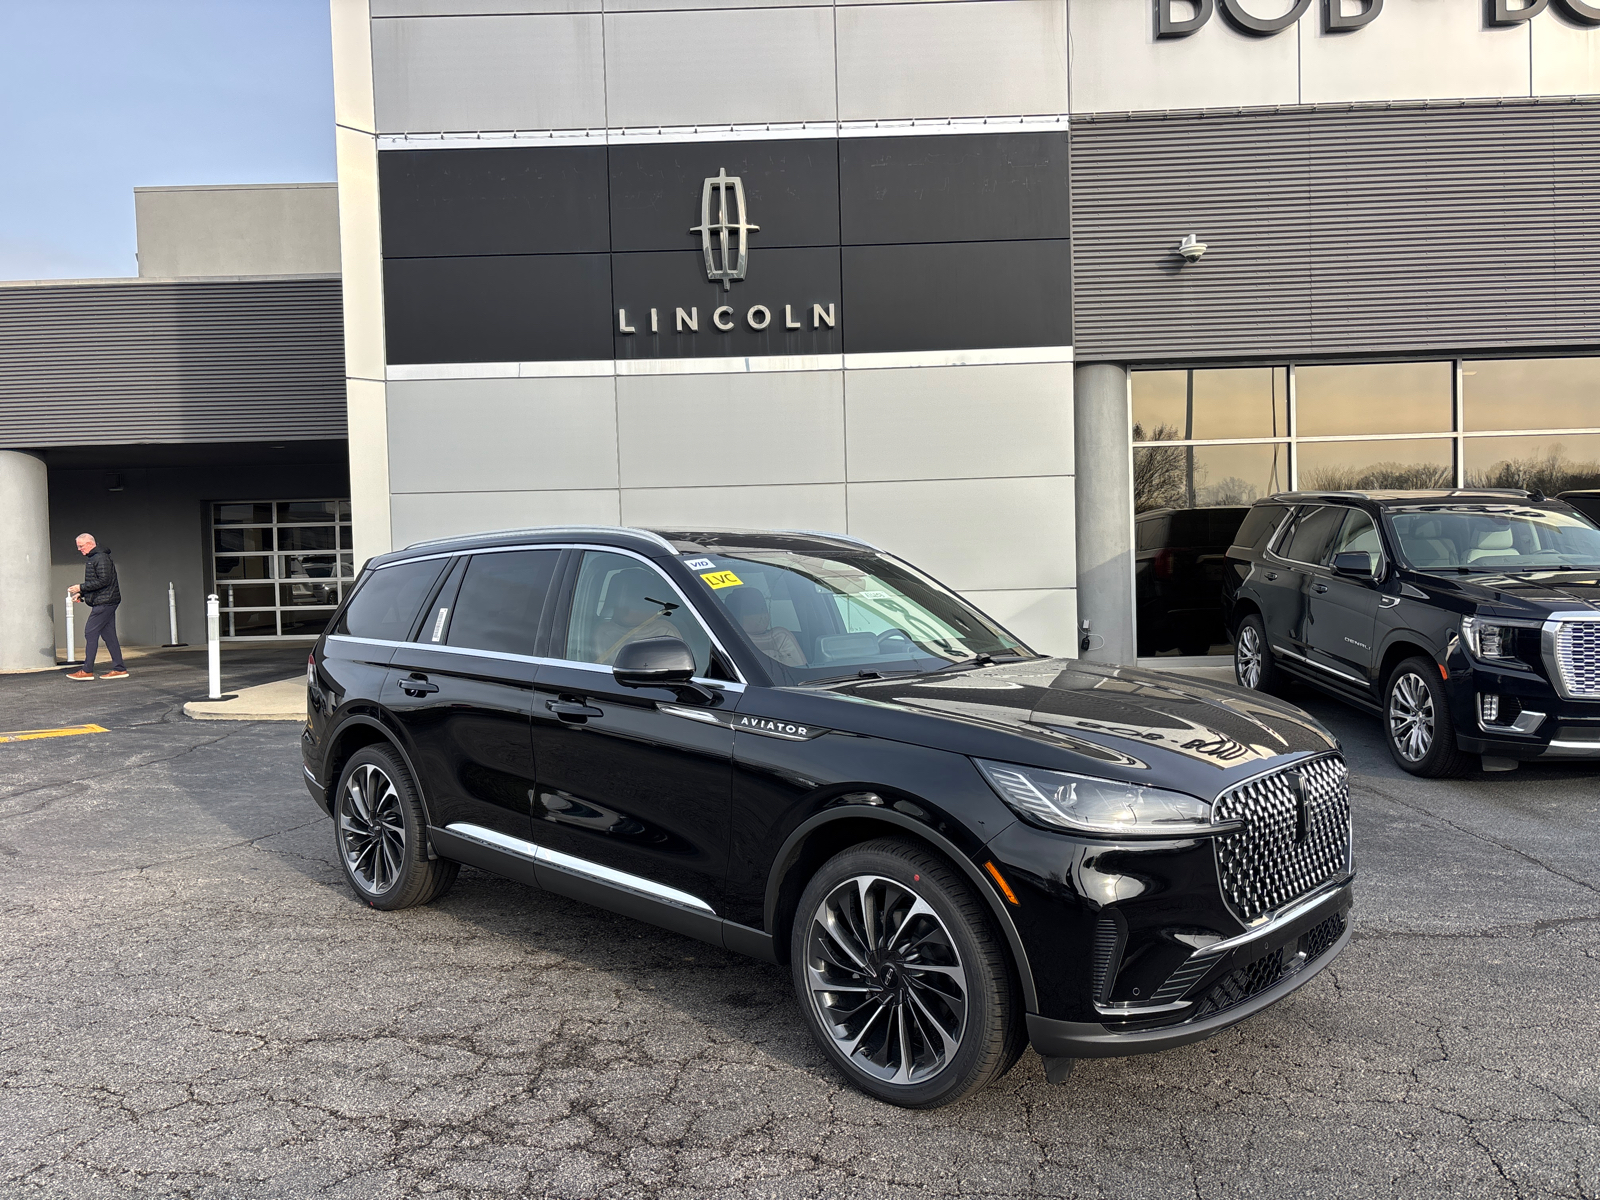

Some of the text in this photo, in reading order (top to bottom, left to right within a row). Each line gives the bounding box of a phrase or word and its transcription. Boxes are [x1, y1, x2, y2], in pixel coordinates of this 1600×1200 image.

[618, 302, 836, 335] LINCOLN
[690, 560, 709, 568] VID
[705, 573, 738, 586] LVC
[1344, 636, 1371, 651] DENALI
[741, 716, 808, 736] AVIATOR
